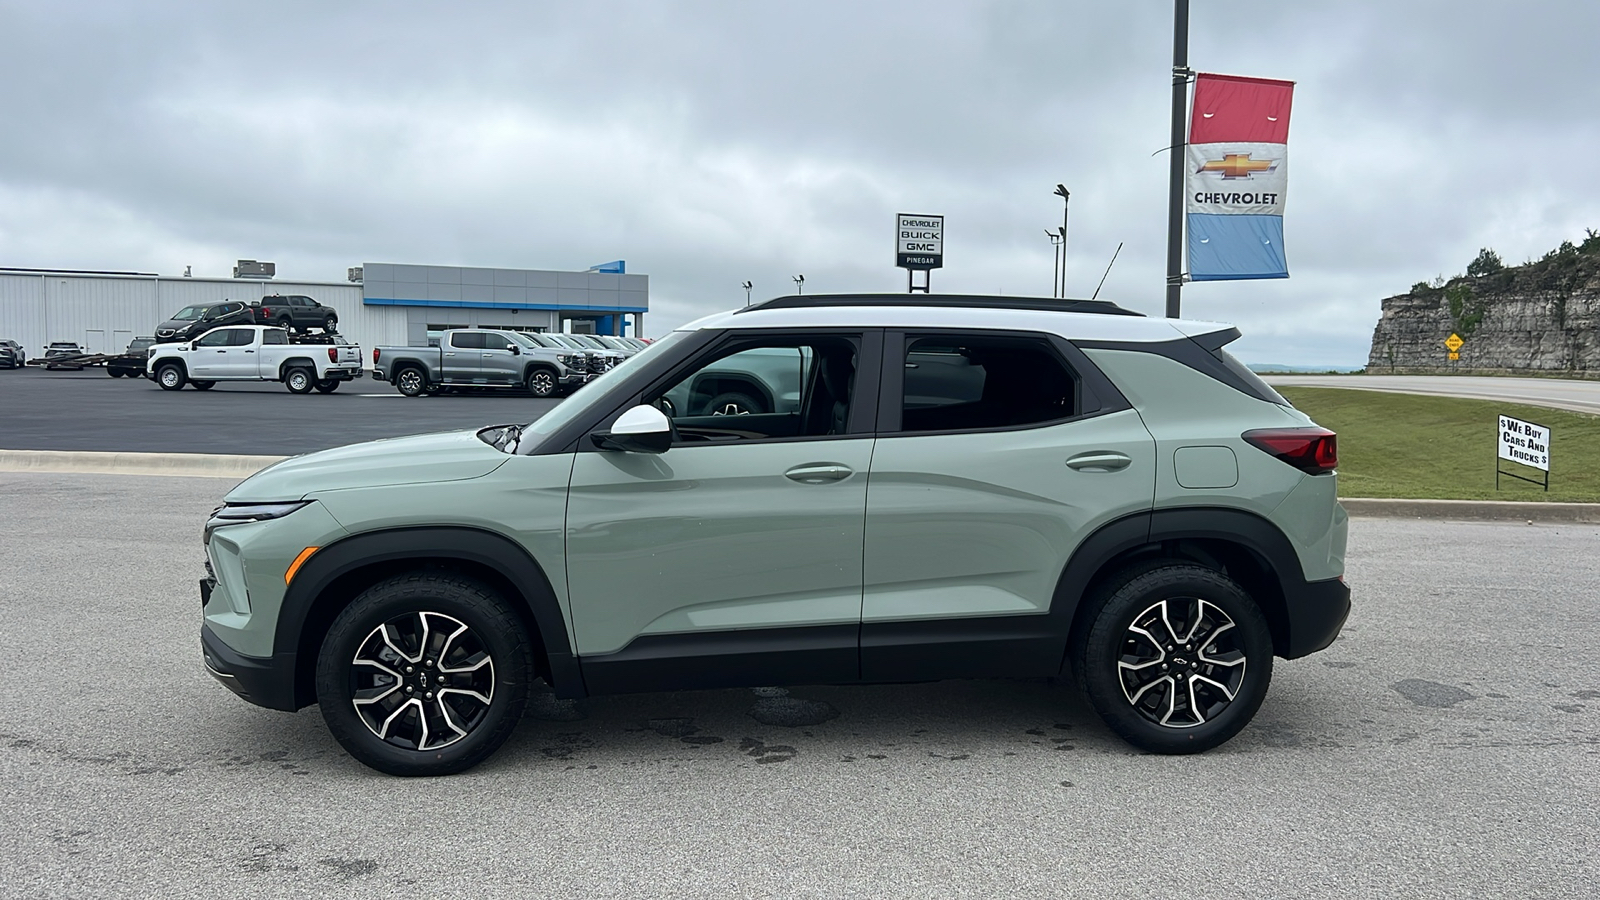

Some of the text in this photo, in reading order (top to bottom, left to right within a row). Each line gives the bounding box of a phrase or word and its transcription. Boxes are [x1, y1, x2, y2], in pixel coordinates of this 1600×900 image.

[1194, 192, 1278, 205] CHEVROLET
[902, 219, 940, 228] CHEVROLET
[901, 231, 940, 239] BUICK
[906, 243, 935, 251] GMC
[1524, 425, 1542, 439] BUY
[1503, 431, 1545, 453] CARS AND
[1508, 445, 1540, 464] TRUCKS
